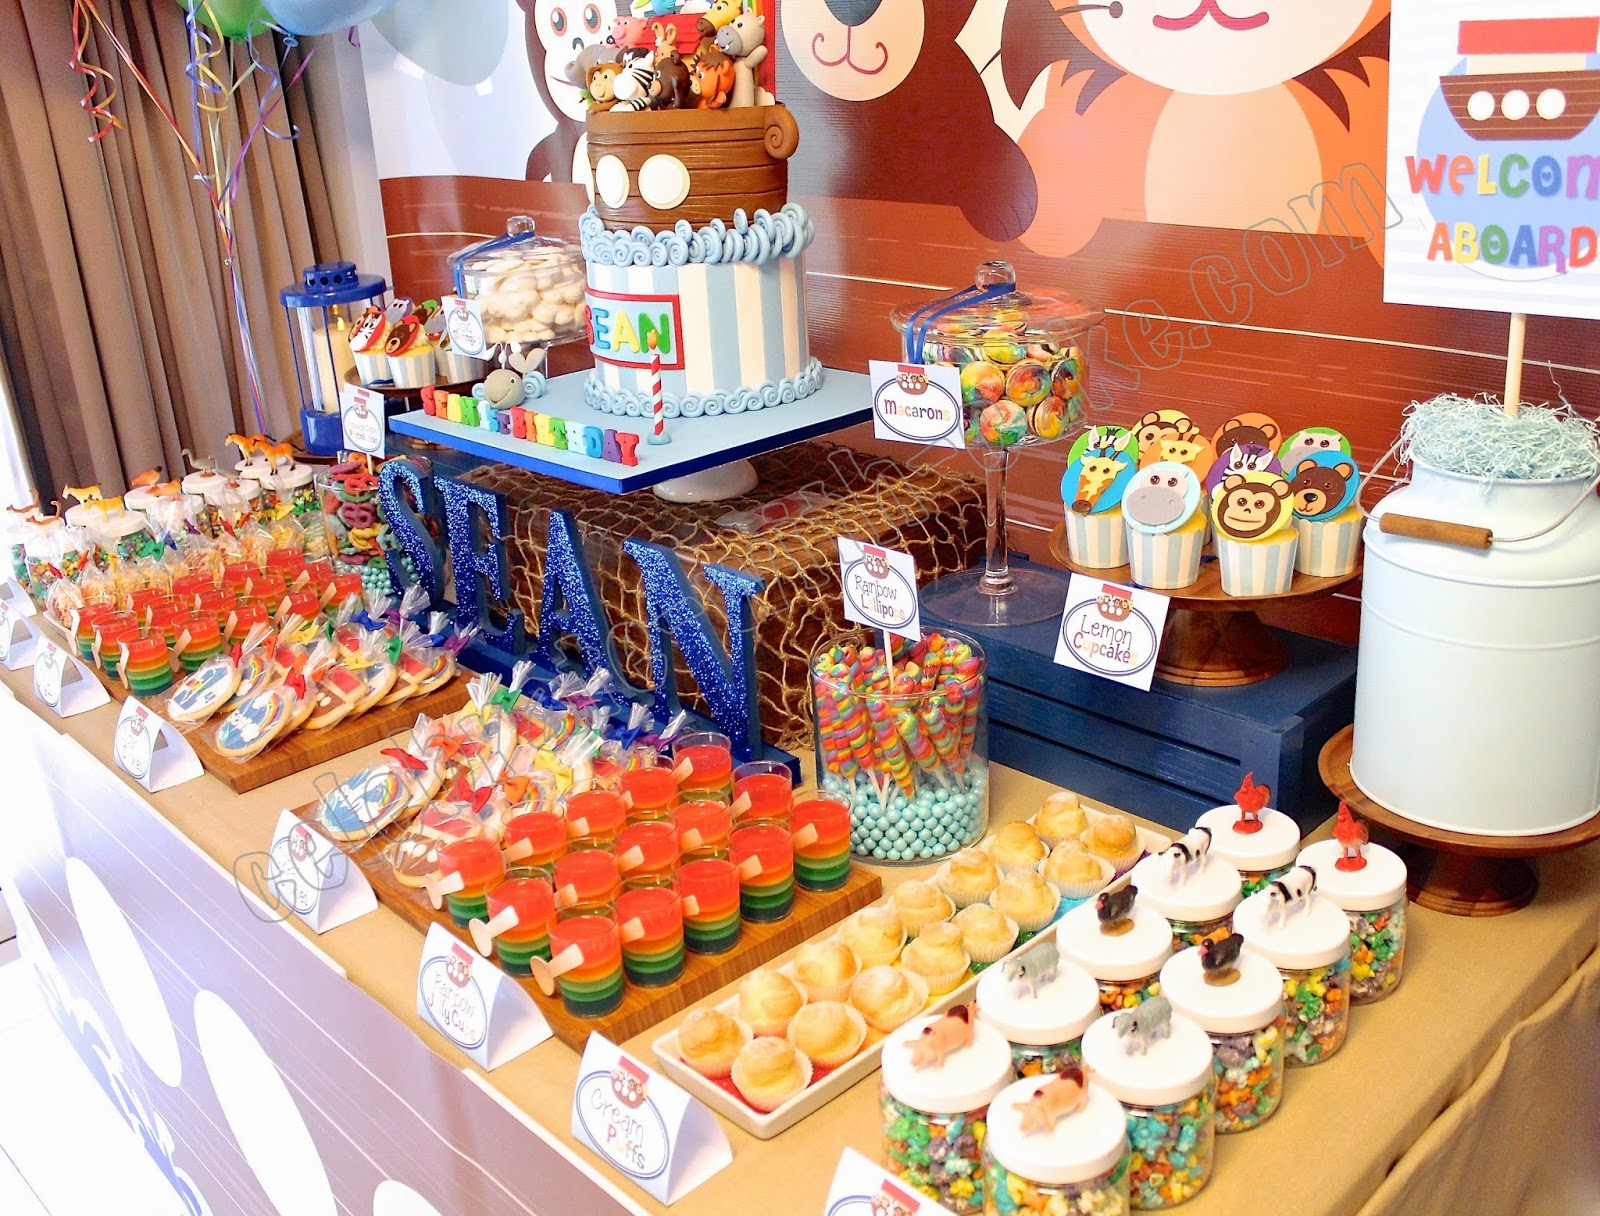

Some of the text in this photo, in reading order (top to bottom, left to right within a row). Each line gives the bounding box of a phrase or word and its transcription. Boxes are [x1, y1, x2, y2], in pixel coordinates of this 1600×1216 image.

[1427, 222, 1598, 274] ABOARD
[420, 385, 480, 428] SEAN
[510, 405, 640, 467] BIRTHDAY
[377, 459, 768, 763] SEAN
[854, 574, 898, 600] Rainbow
[1073, 631, 1138, 667] Cupcakes
[1080, 614, 1133, 651] Lemon
[590, 1087, 645, 1149] Cream
